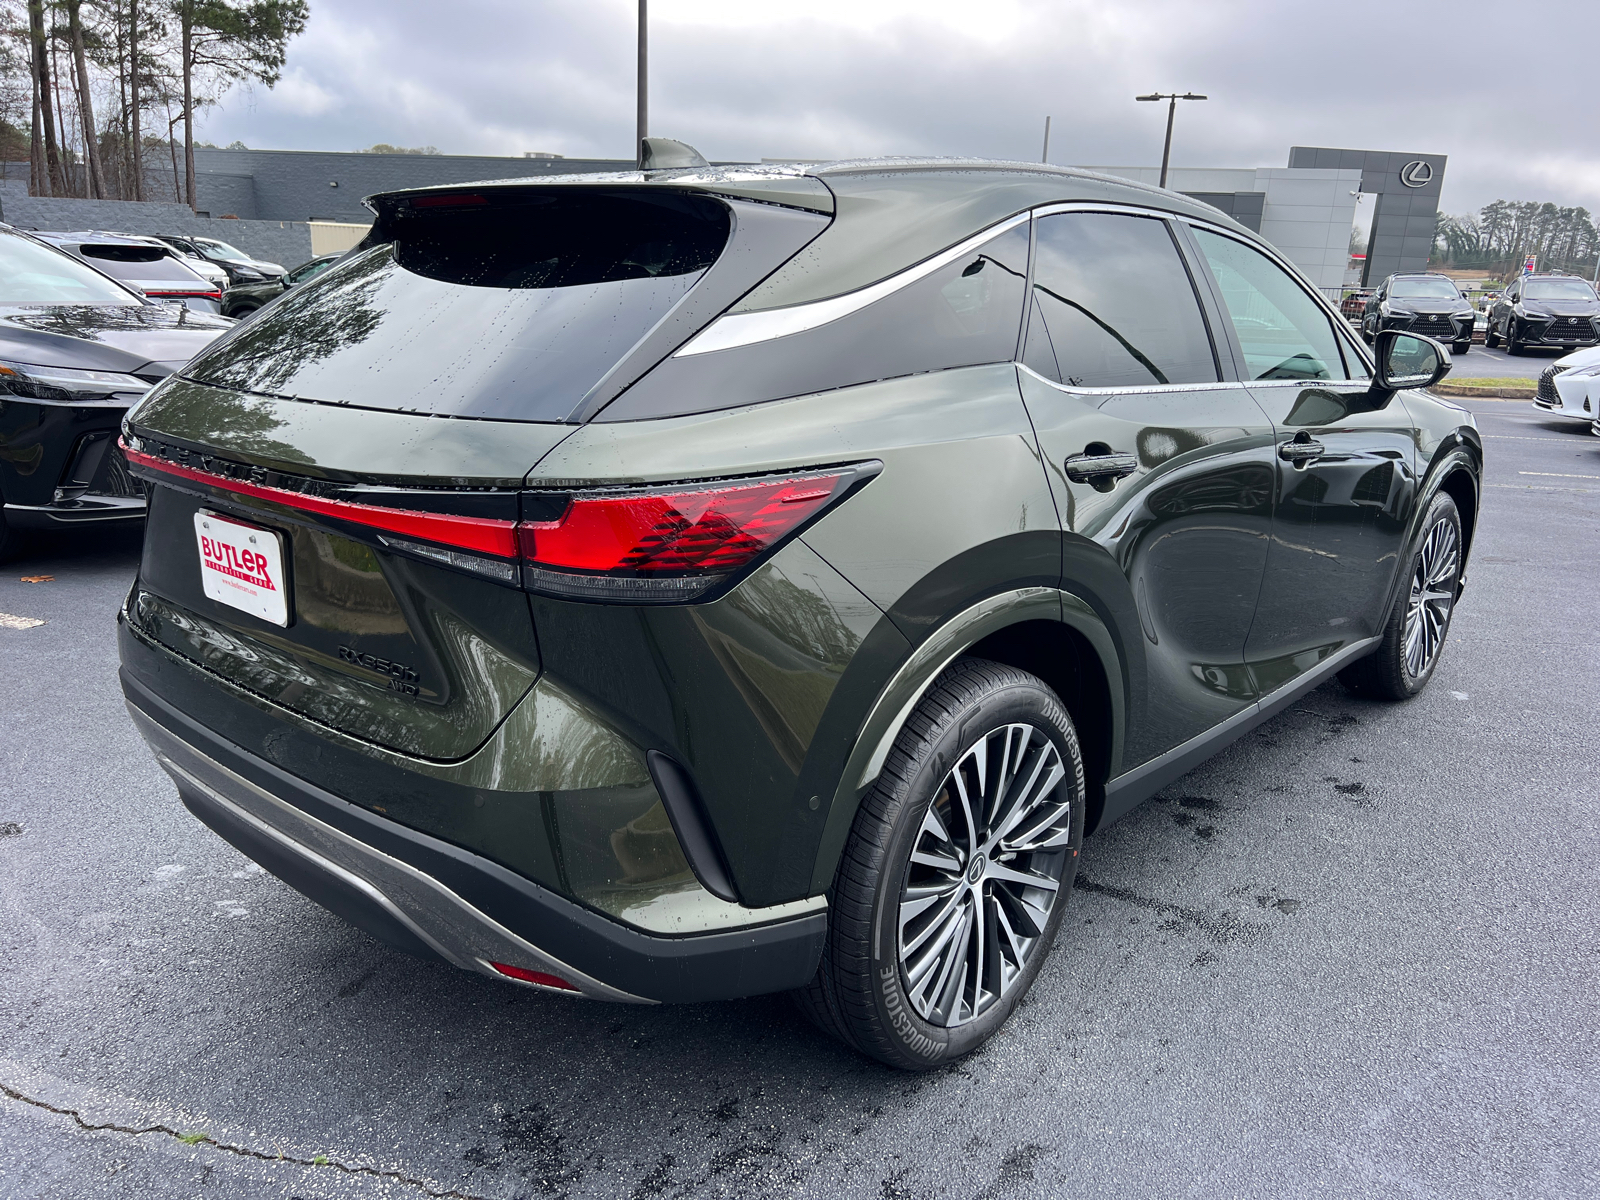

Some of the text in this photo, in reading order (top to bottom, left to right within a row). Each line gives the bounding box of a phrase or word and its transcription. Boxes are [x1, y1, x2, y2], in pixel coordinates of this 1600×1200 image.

[249, 576, 274, 590] GROUP
[386, 679, 420, 697] AWD
[1041, 697, 1085, 802] BRIDGESTONE
[880, 964, 948, 1060] BRIDGESTONE
